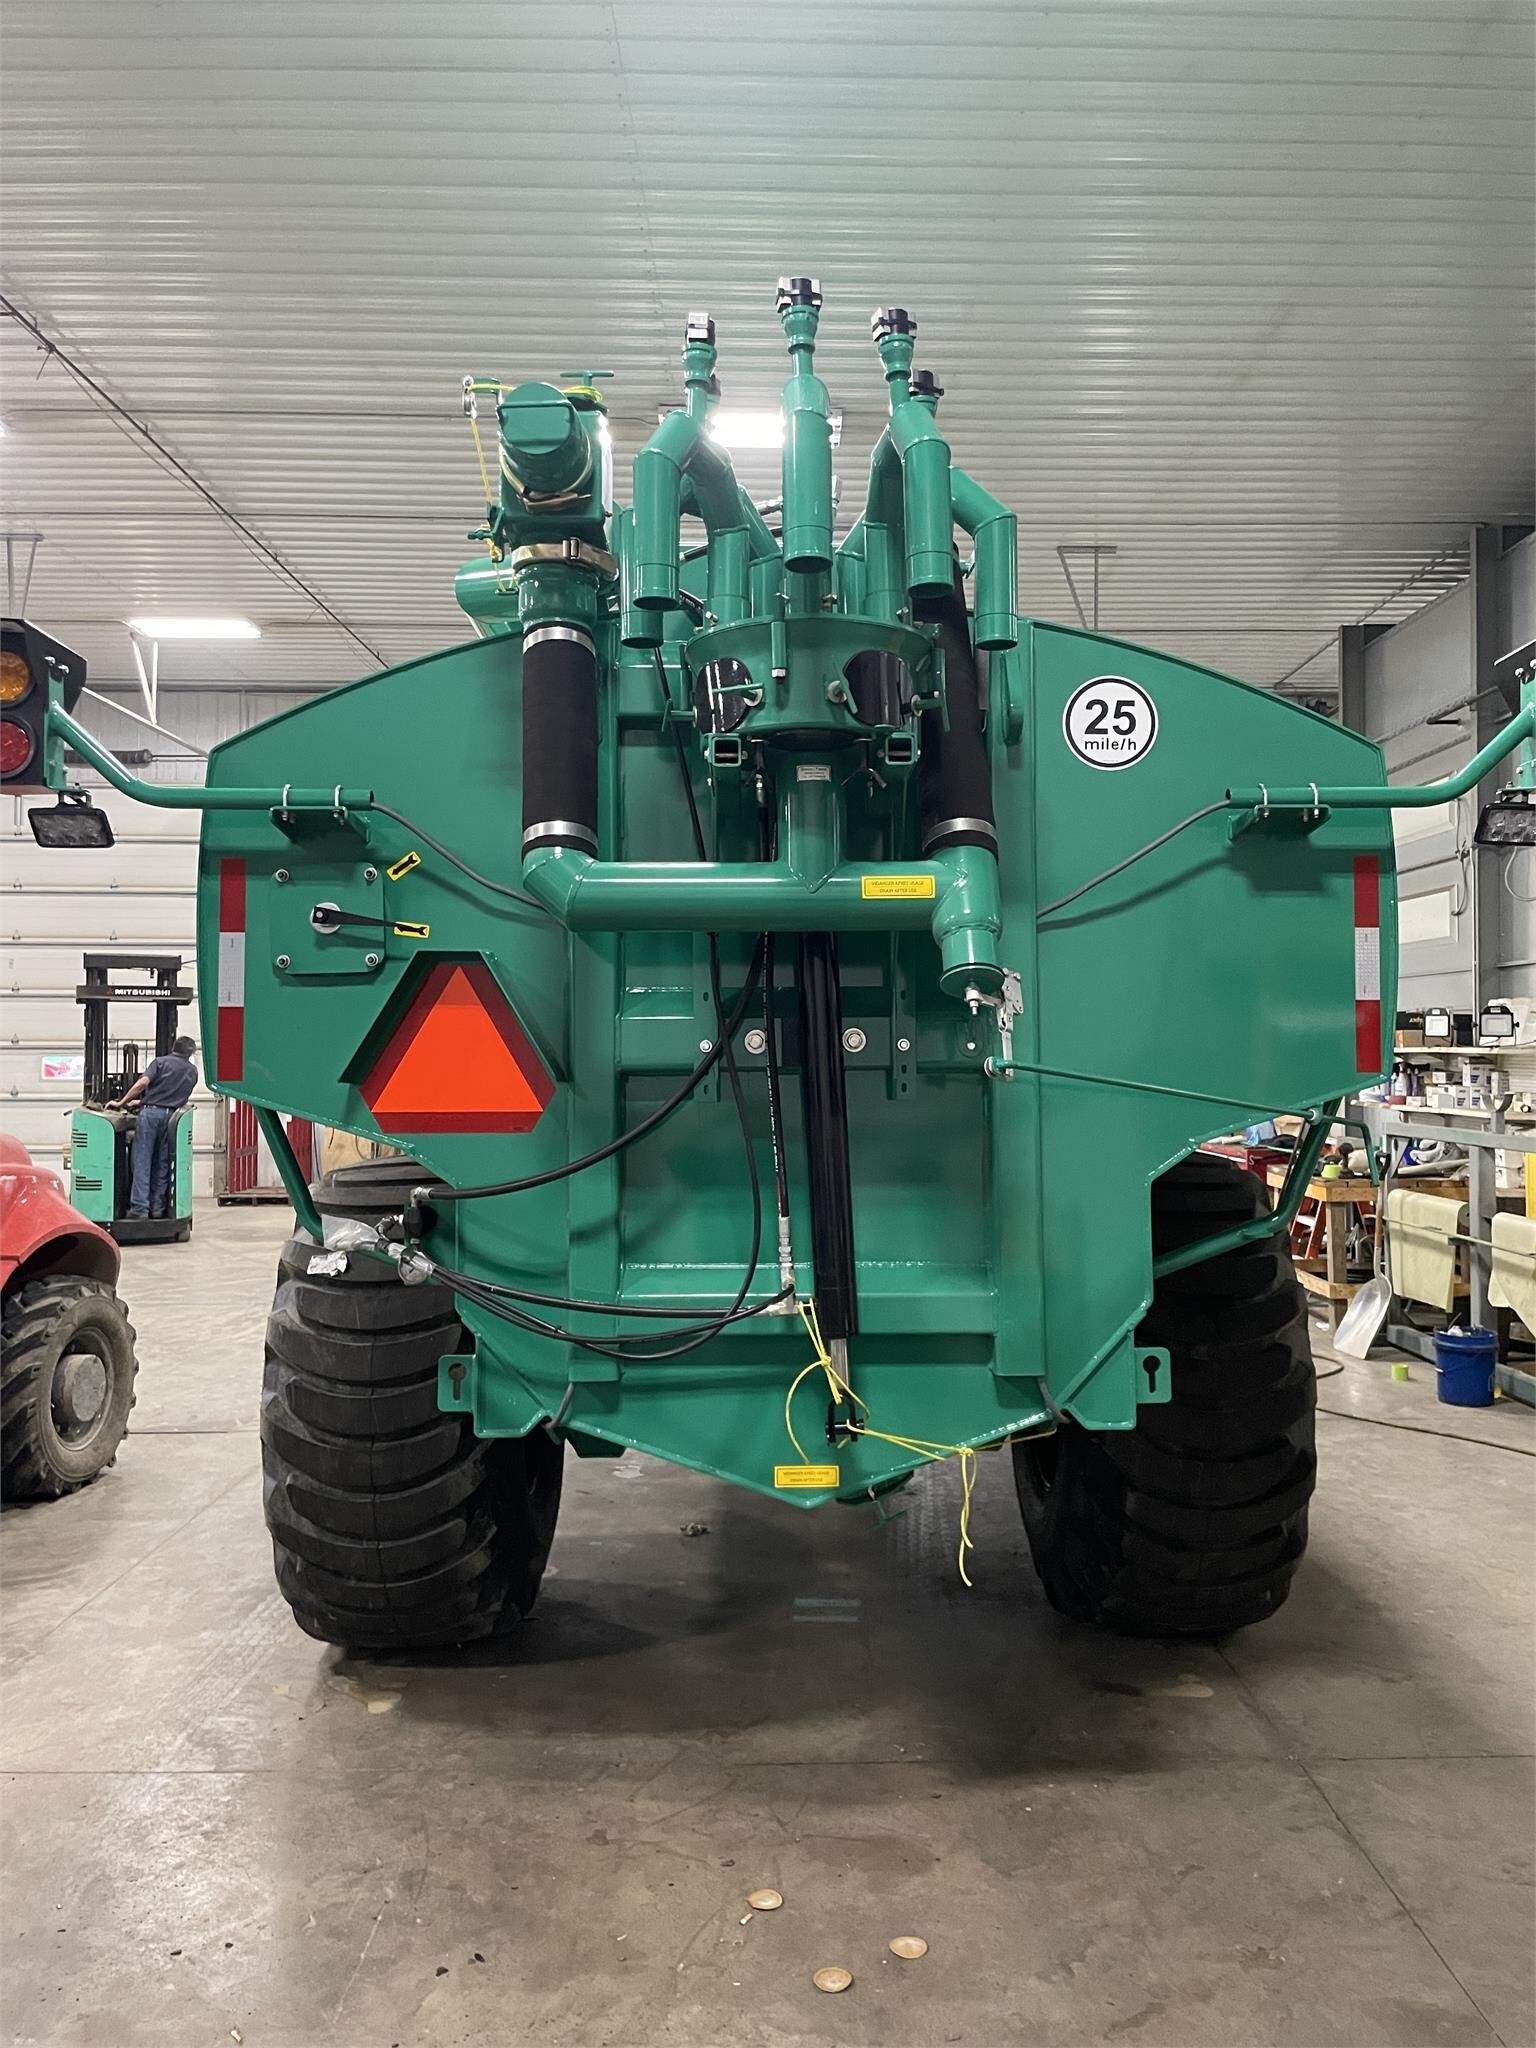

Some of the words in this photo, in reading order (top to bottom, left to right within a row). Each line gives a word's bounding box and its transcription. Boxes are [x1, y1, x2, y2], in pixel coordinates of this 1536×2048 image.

[1084, 699, 1137, 736] 25
[1084, 737, 1137, 751] mile/h
[114, 988, 171, 996] MITSUBISHI
